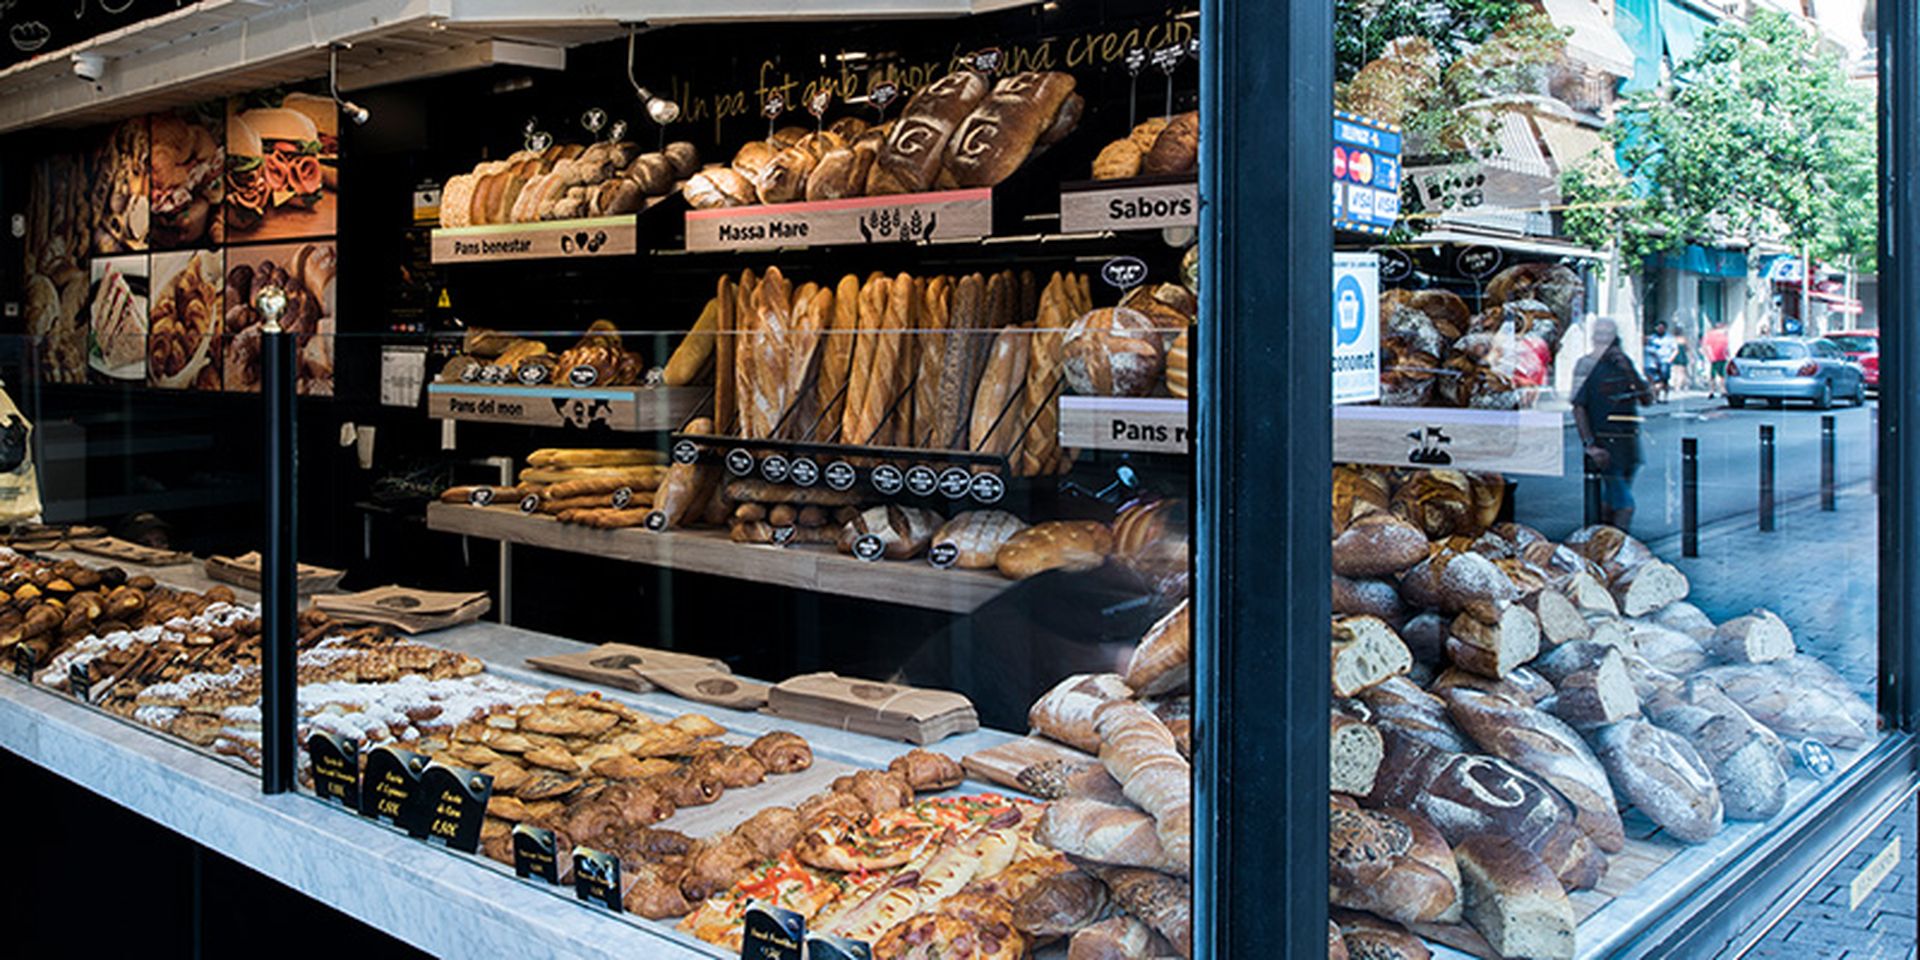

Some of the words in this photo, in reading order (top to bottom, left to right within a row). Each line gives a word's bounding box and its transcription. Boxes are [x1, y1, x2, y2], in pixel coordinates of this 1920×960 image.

[714, 90, 750, 145] pa
[754, 59, 799, 118] ft
[995, 40, 1056, 77] una
[897, 125, 933, 154] G
[962, 123, 999, 156] G
[1109, 196, 1192, 220] Sabors
[719, 223, 765, 242] Massa
[769, 220, 810, 239] Mare
[454, 241, 481, 255] Pans
[482, 239, 531, 254] benestar
[450, 398, 475, 412] Pans
[478, 398, 494, 414] del
[1112, 419, 1168, 442] Pans
[1458, 759, 1526, 809] G
